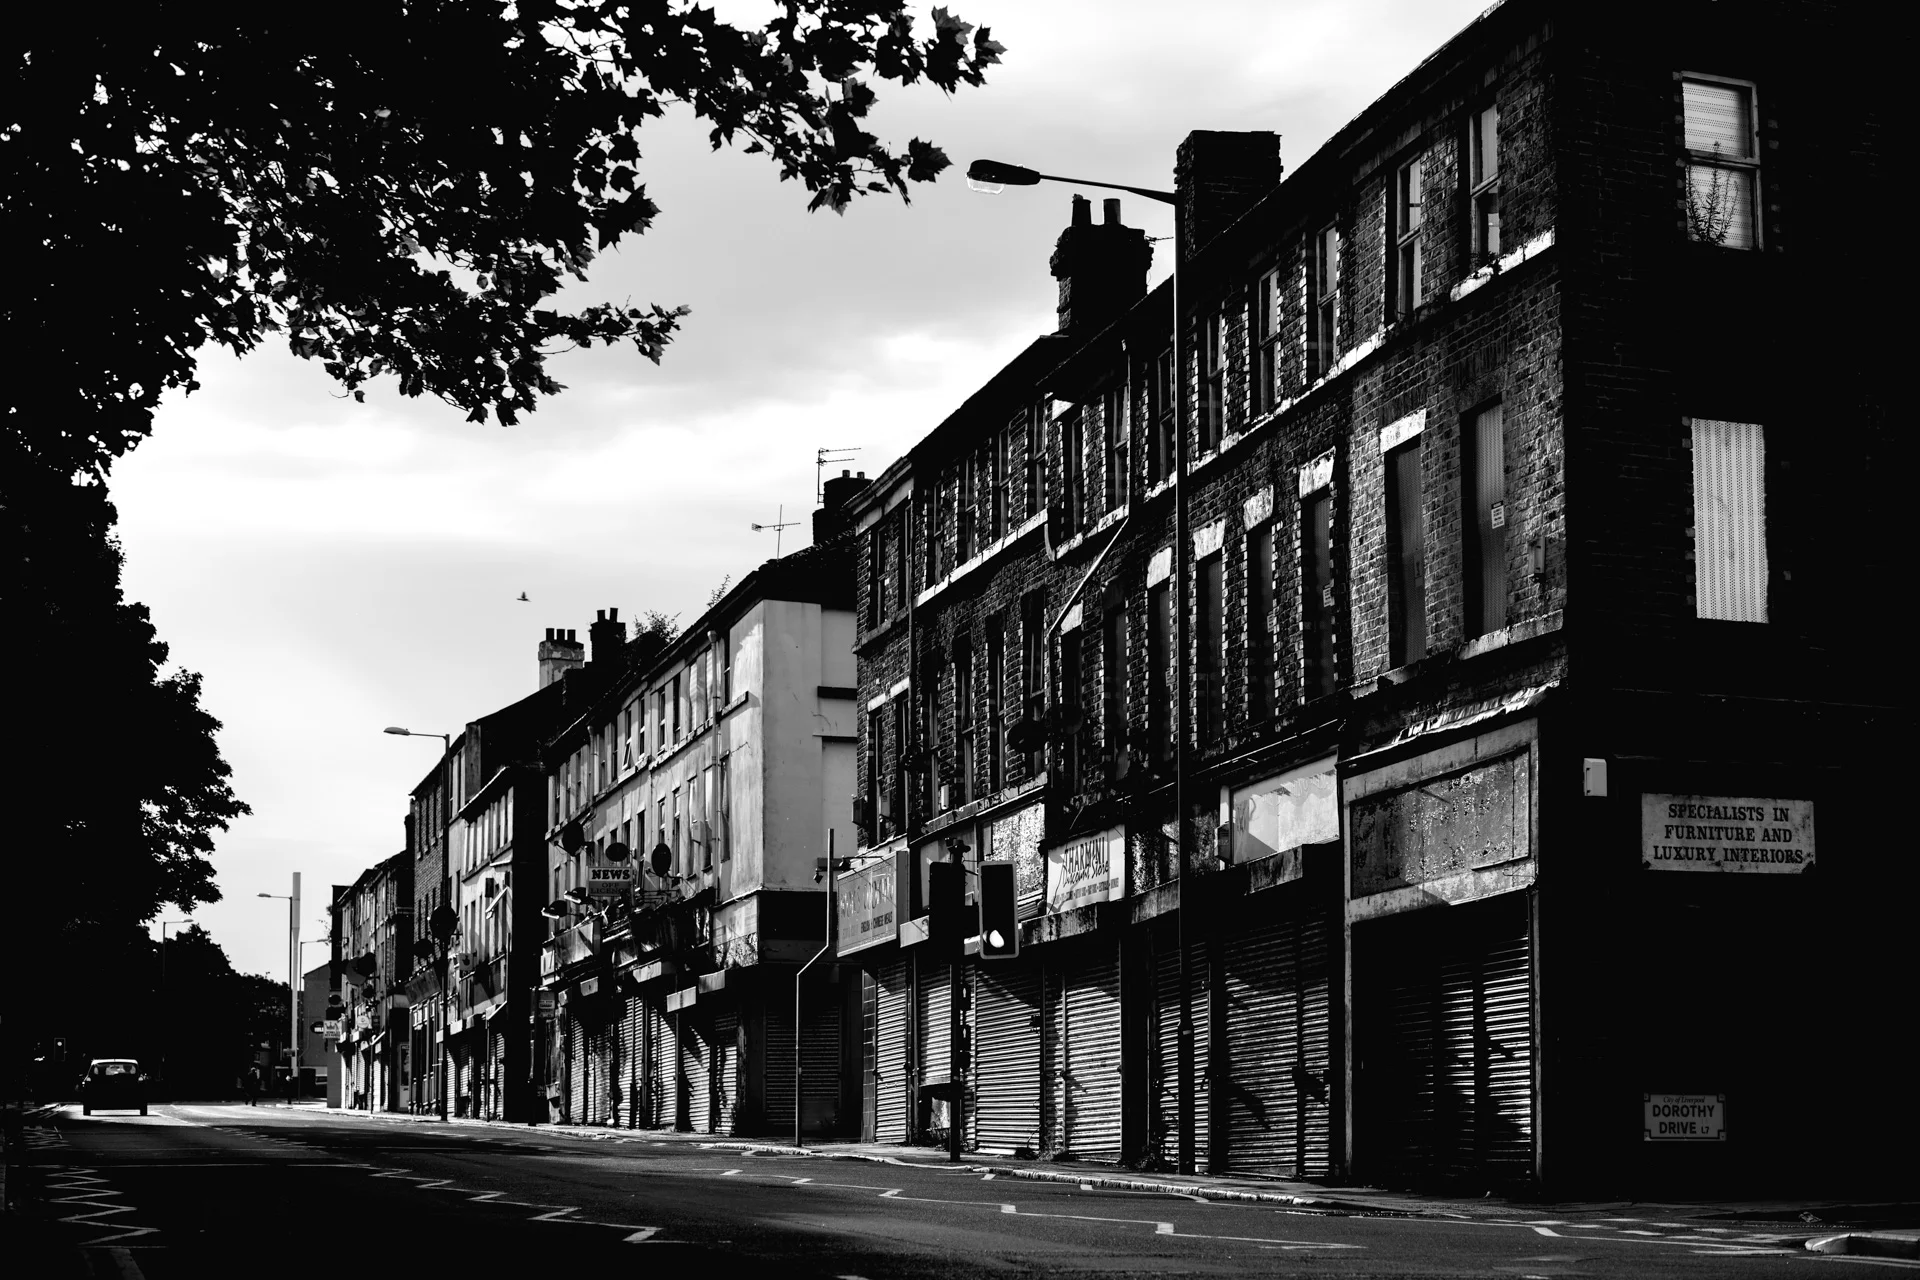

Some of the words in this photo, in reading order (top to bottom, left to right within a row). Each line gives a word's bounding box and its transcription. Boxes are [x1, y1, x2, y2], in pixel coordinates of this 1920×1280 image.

[1668, 803, 1764, 822] SPECIALISTS
[1773, 807, 1790, 822] IN
[1664, 824, 1756, 842] FURNITURE
[1761, 828, 1793, 843] AND
[1653, 845, 1717, 862] LUXURY
[1723, 847, 1804, 864] INTERIORS
[591, 869, 630, 880] NEWS
[1652, 1104, 1715, 1118] DOROTHY
[1659, 1121, 1697, 1134] DRIVE
[1701, 1126, 1710, 1134] L7
